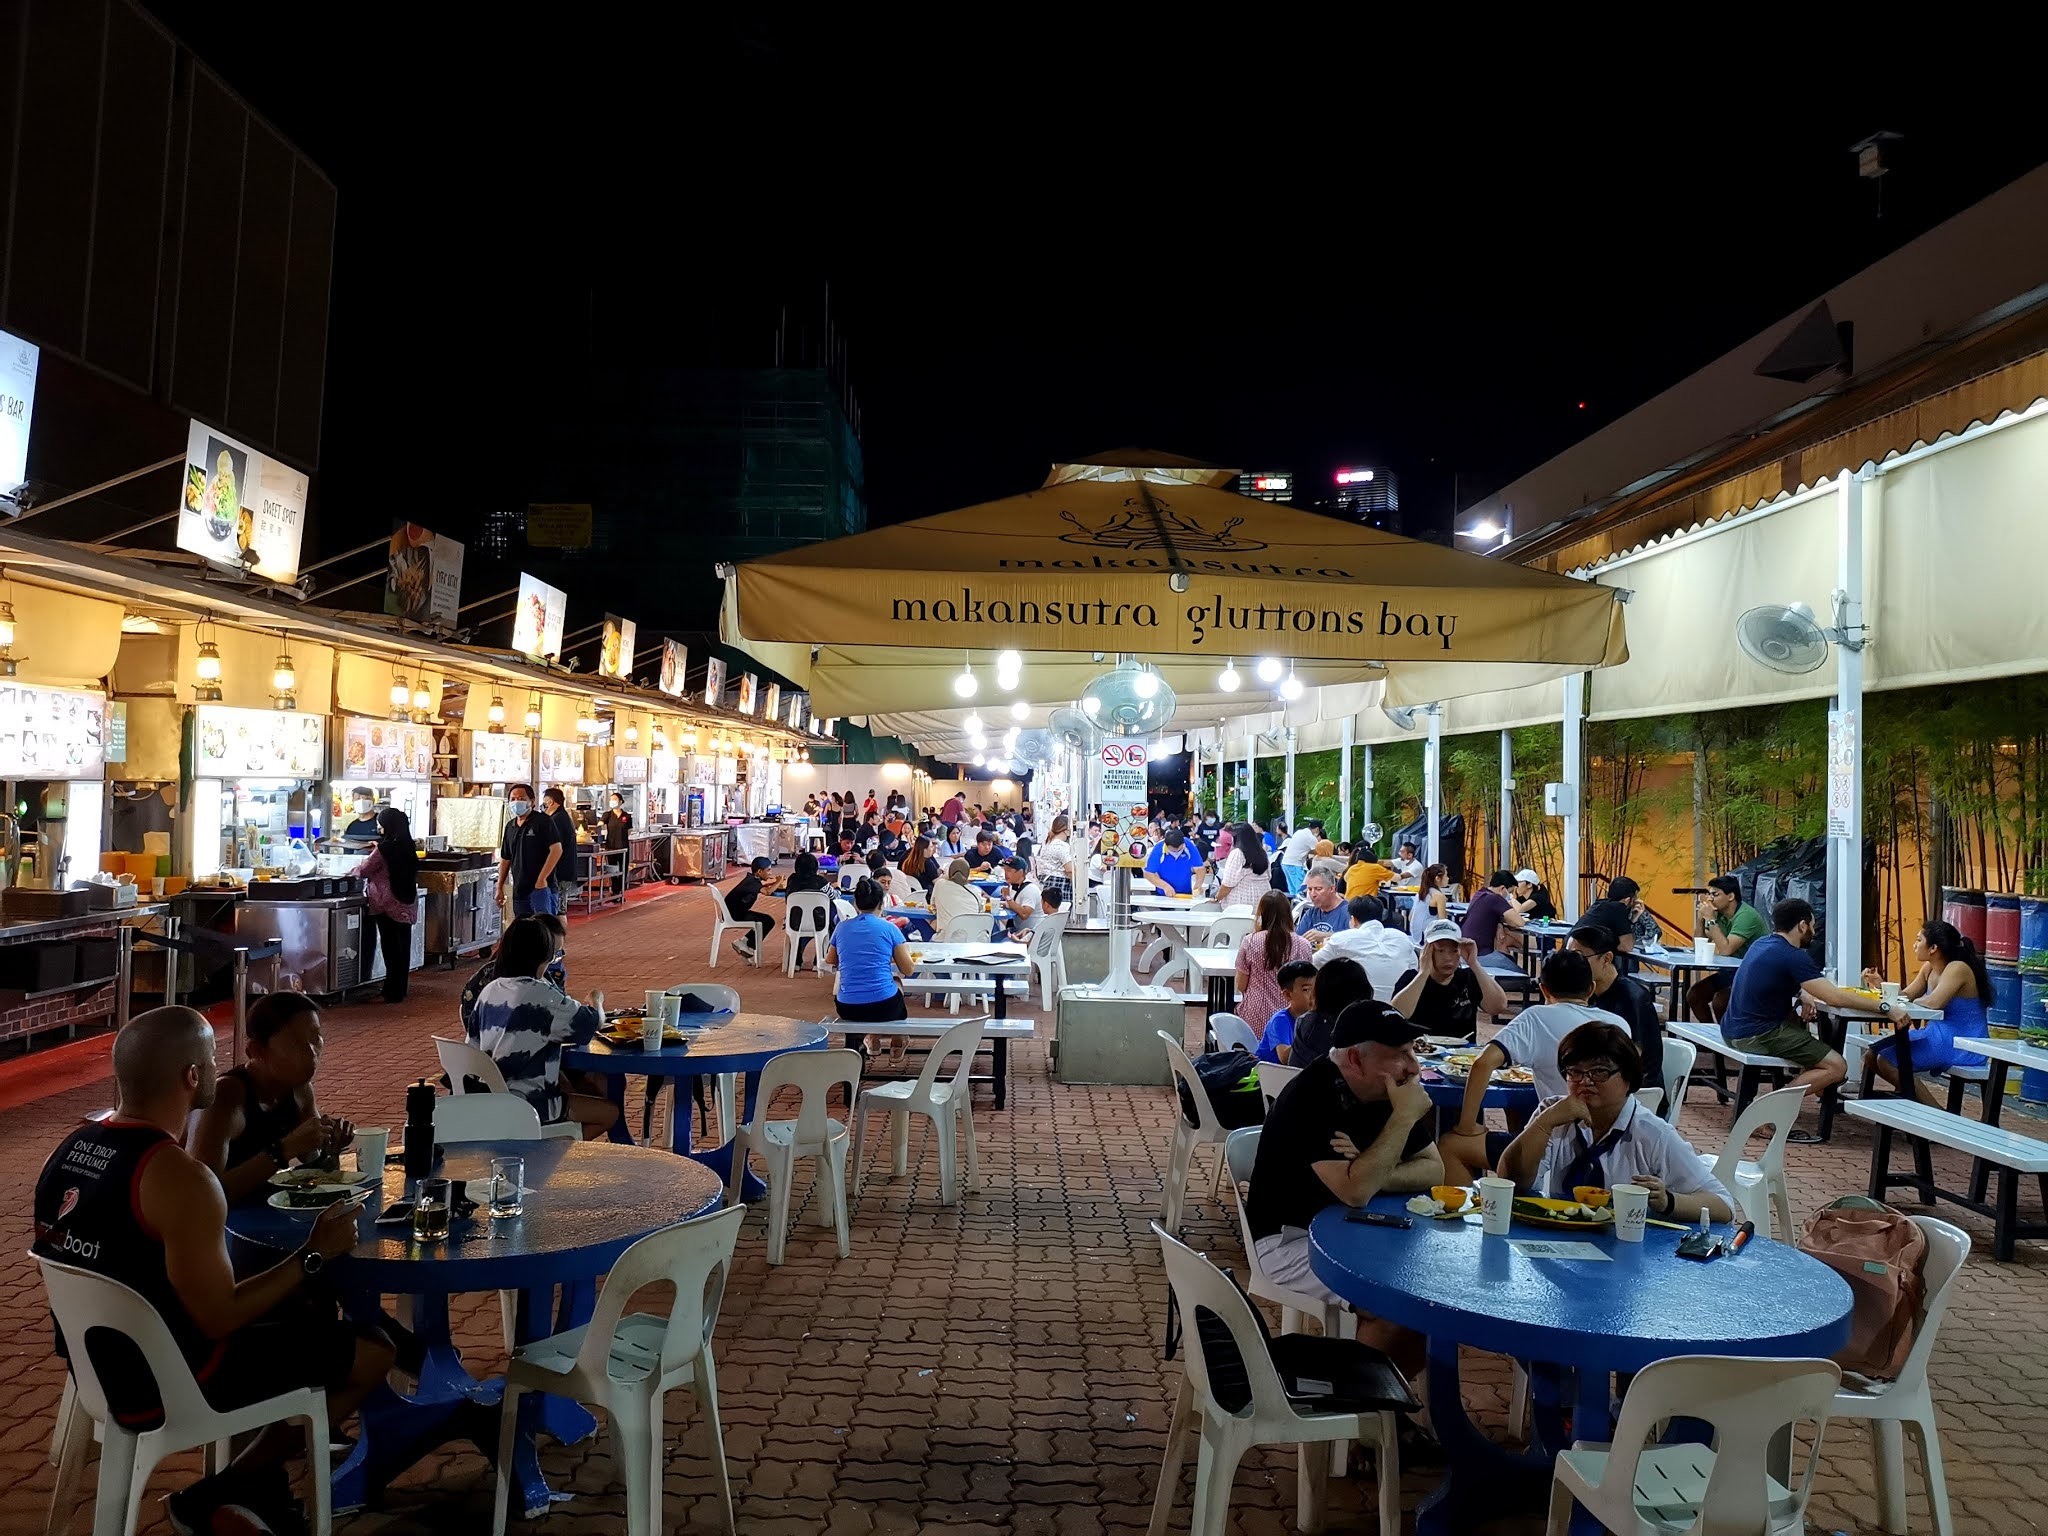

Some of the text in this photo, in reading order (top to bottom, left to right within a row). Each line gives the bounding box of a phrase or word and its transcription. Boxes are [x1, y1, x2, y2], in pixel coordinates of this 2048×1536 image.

[7, 396, 24, 421] BAR
[262, 499, 297, 526] SWEET SPOT
[999, 556, 1355, 578] makansutra
[891, 588, 1458, 650] makansutra gluttons bay
[67, 1150, 109, 1171] PERFUMES
[74, 1140, 117, 1159] ONE DROP
